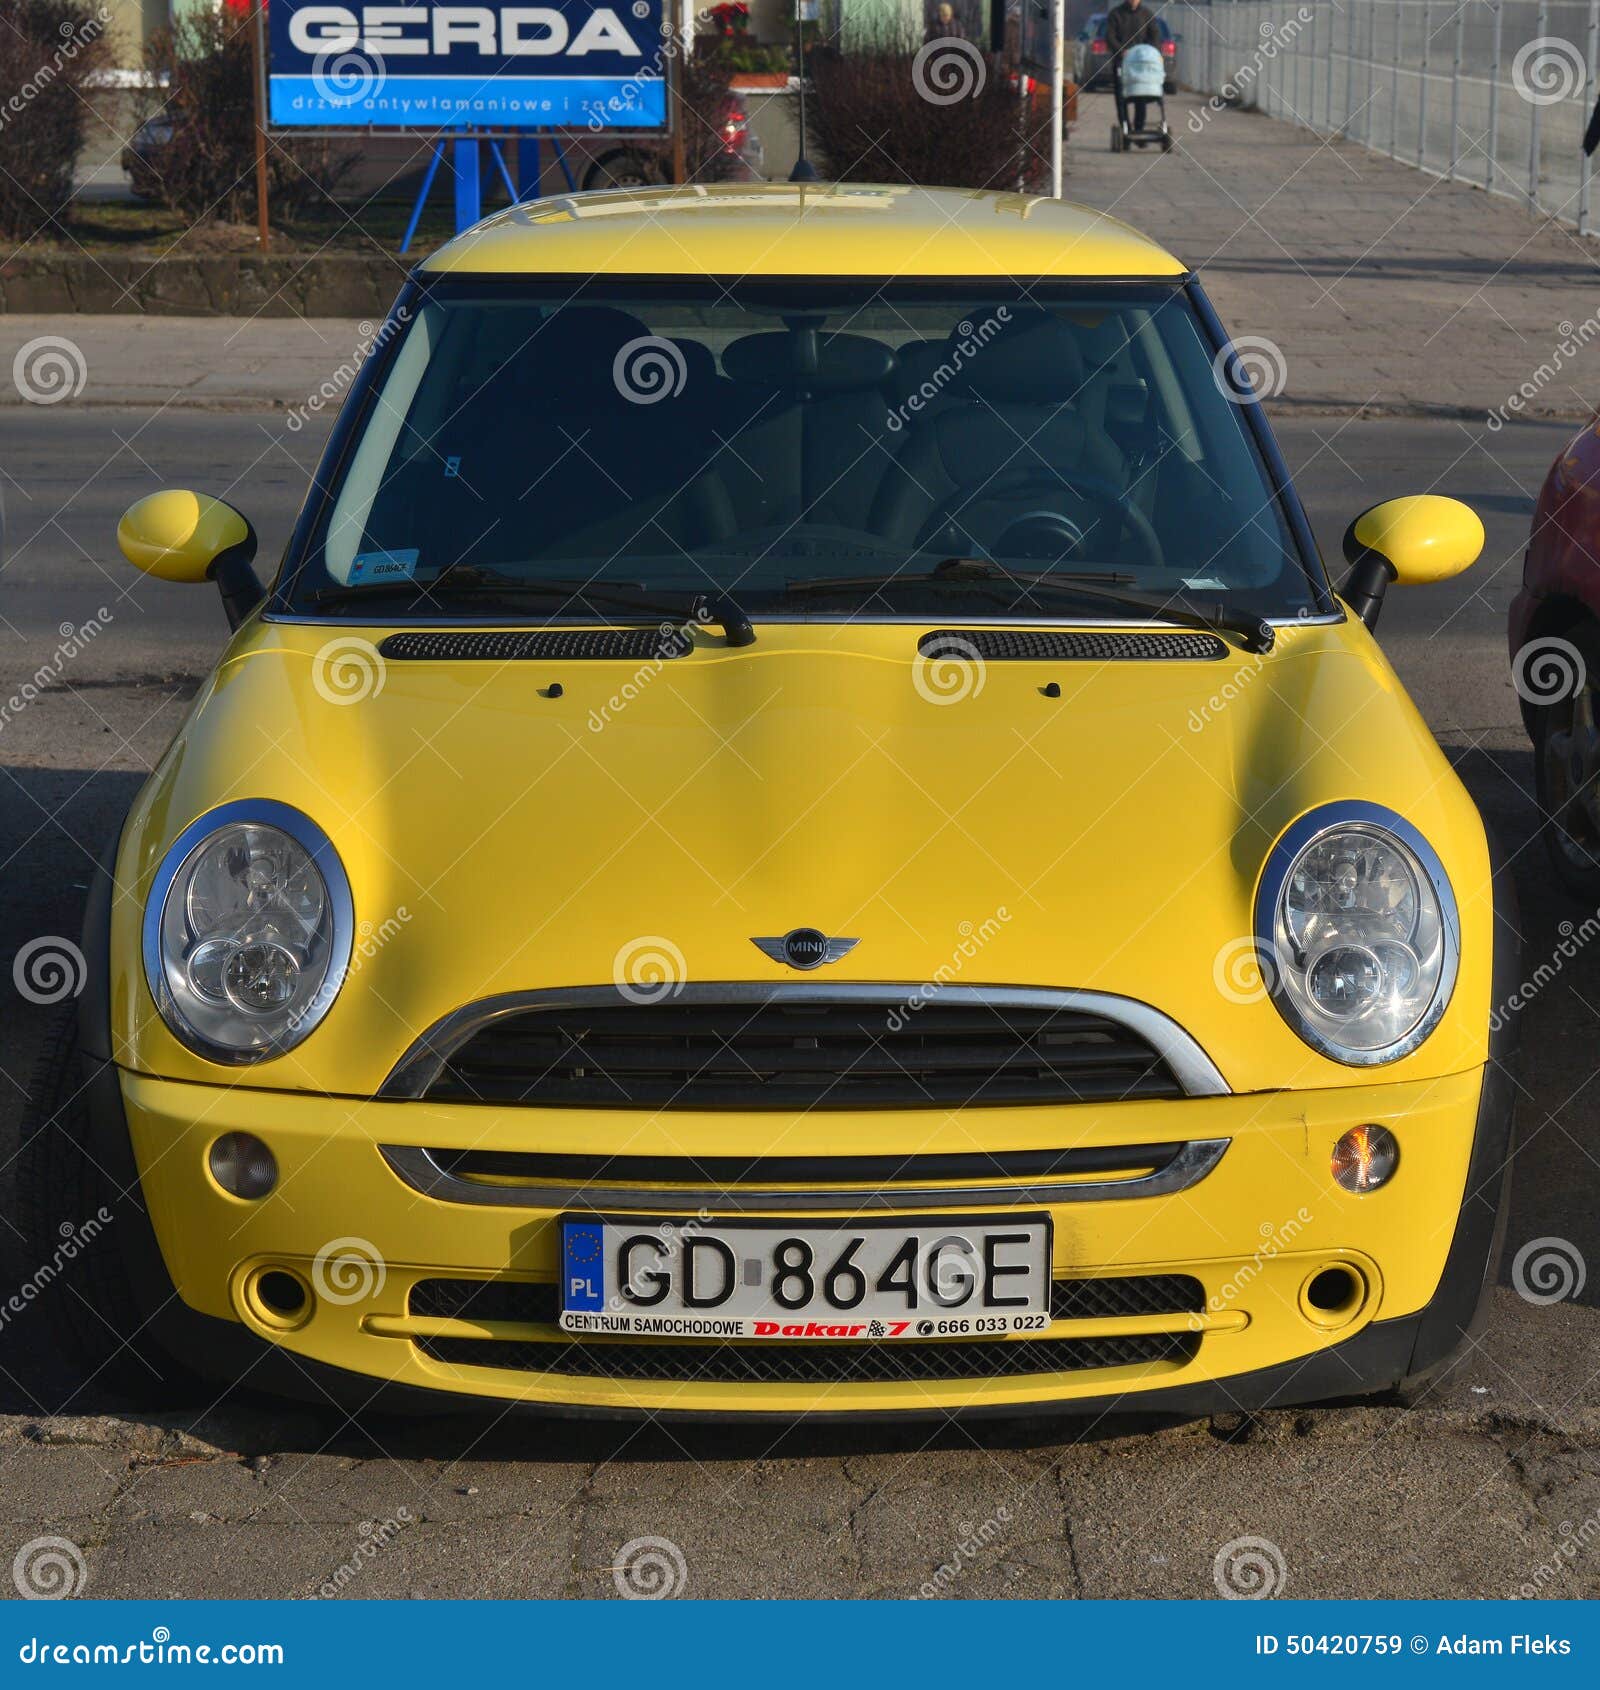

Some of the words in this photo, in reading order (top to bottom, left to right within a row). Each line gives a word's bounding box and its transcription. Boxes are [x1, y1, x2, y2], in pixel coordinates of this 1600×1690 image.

[789, 942, 823, 953] MINI
[617, 1234, 737, 1309] GD
[772, 1233, 1031, 1310] 864GE
[570, 1278, 598, 1298] PL
[565, 1314, 631, 1332] CENTRUM
[634, 1317, 744, 1335] SAMOCHODOWE
[753, 1320, 867, 1337] Dakar
[888, 1321, 911, 1336] 7
[938, 1319, 970, 1334] 666
[976, 1317, 1008, 1332] 033
[1013, 1315, 1045, 1330] 022
